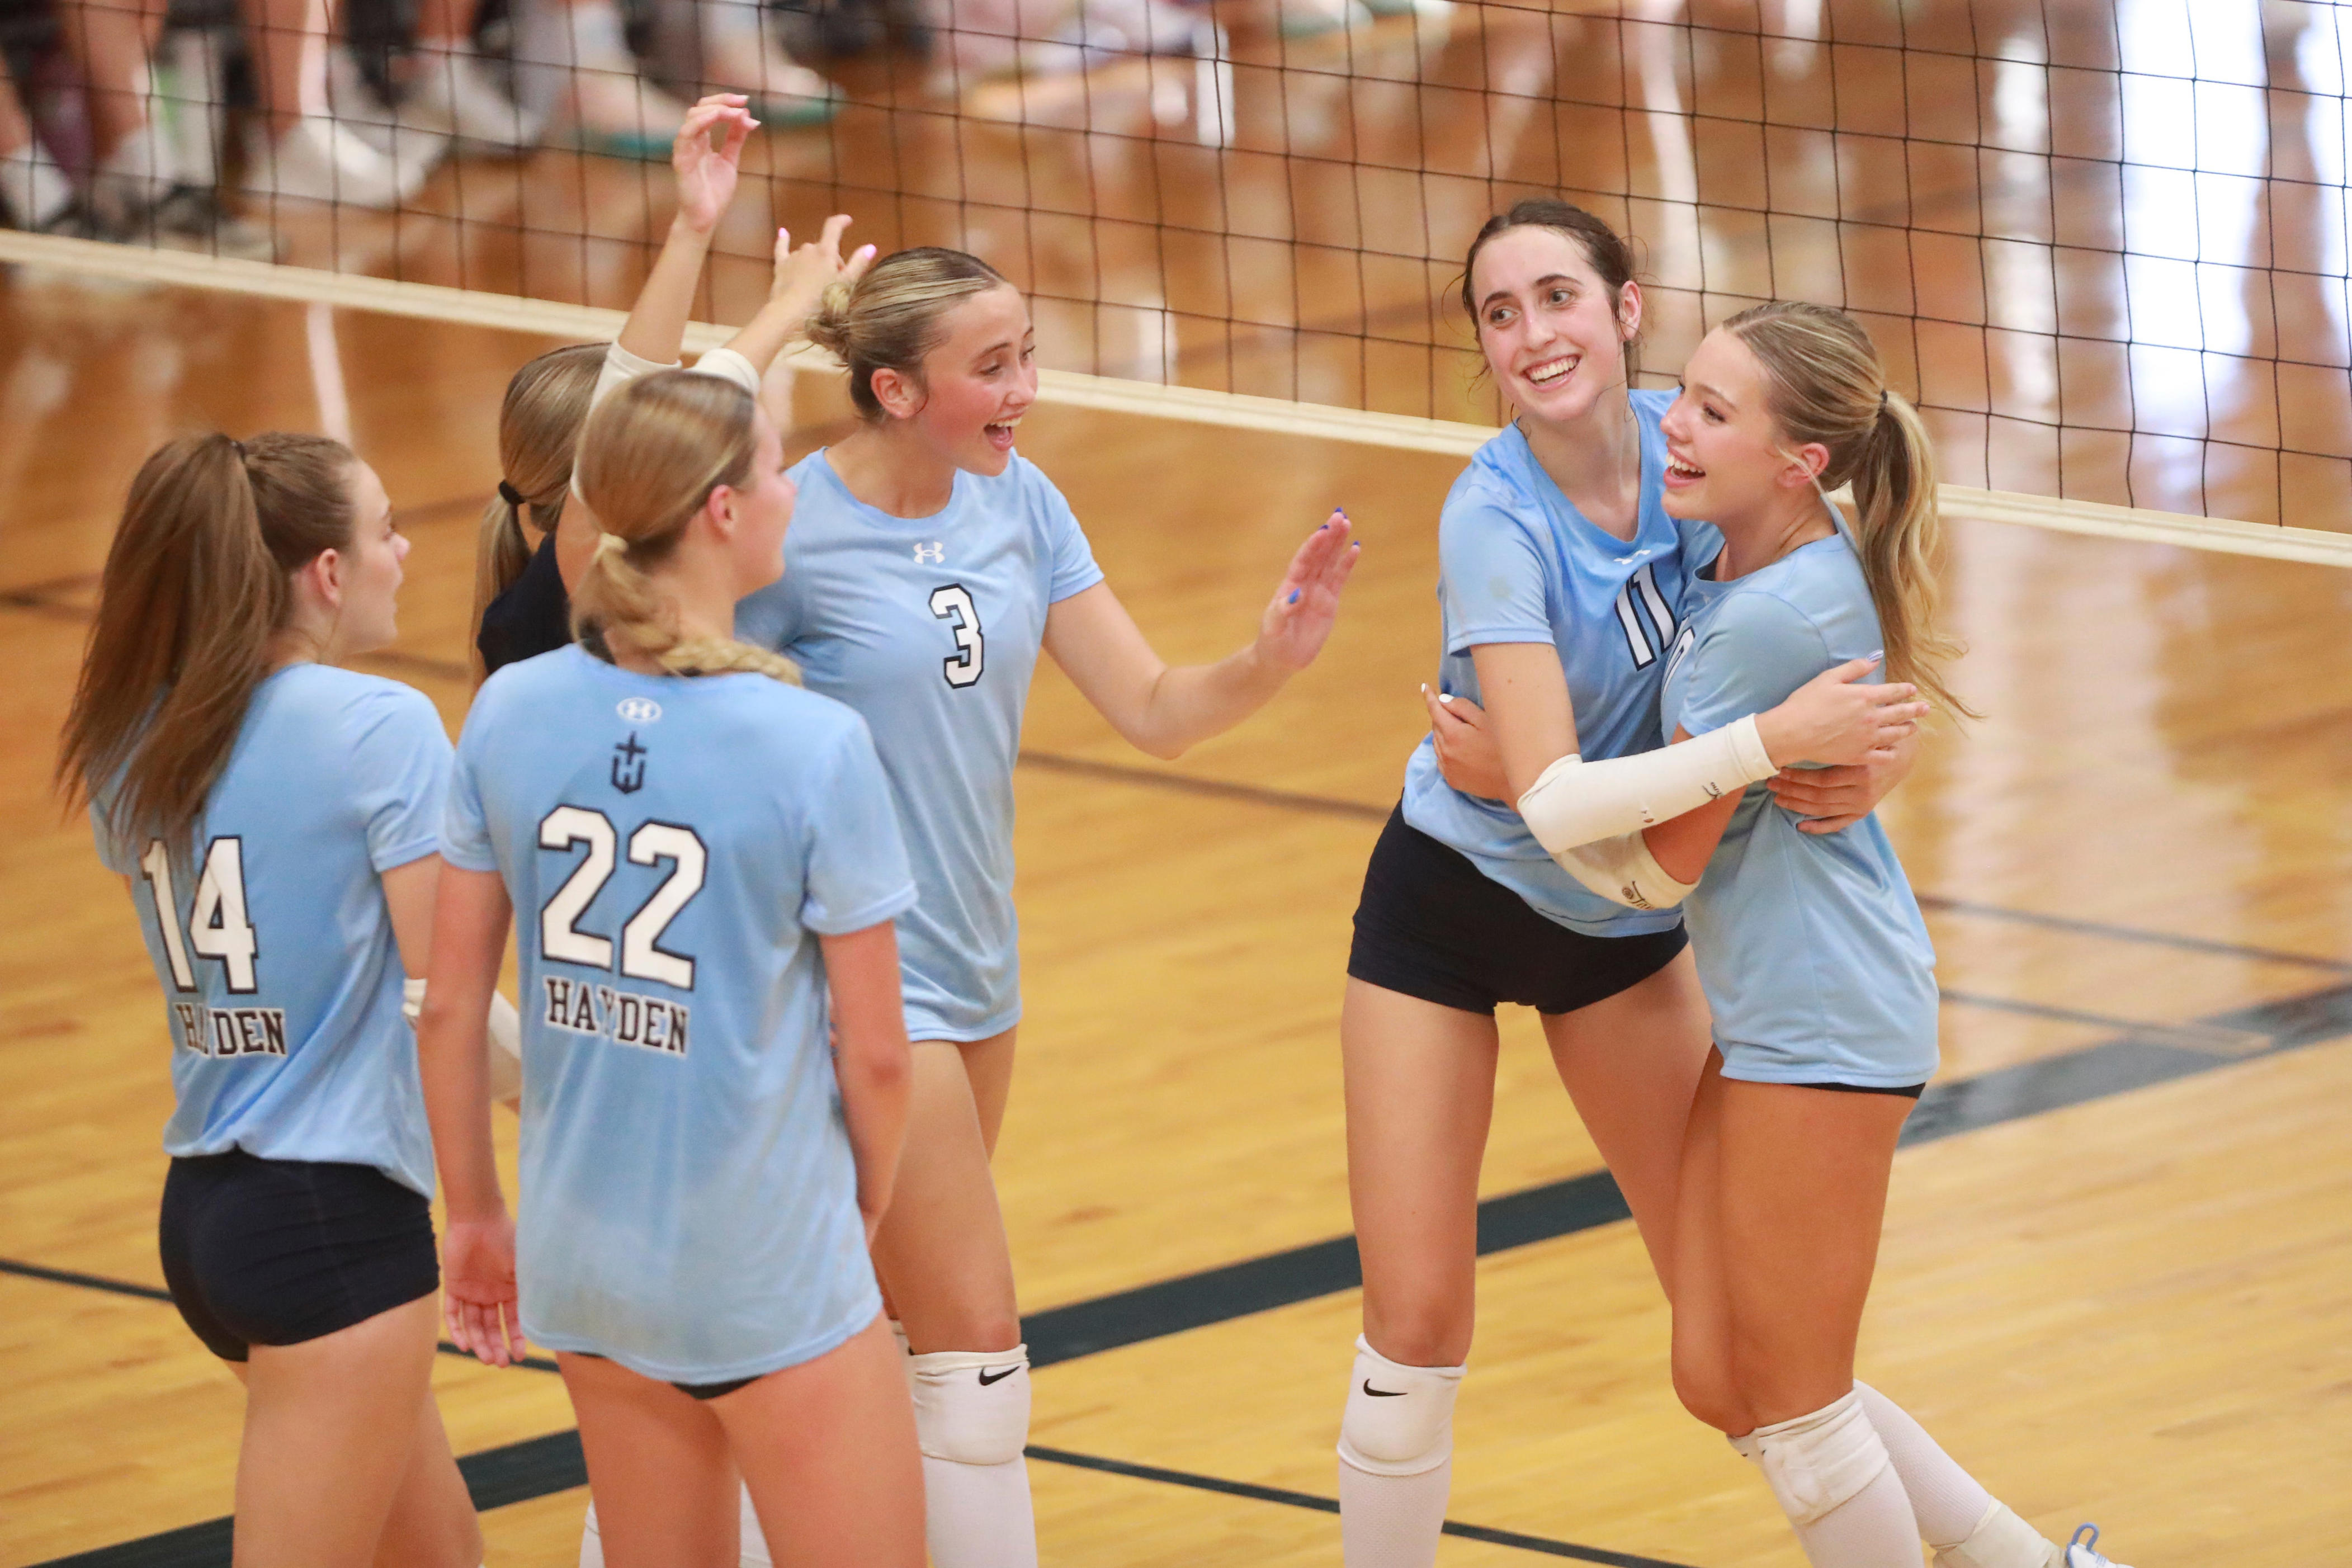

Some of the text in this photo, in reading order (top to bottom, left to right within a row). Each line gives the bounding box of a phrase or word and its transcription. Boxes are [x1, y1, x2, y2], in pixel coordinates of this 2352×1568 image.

[928, 583, 984, 689] 3
[1614, 561, 1678, 672] 11
[141, 834, 259, 994] 14
[538, 804, 708, 991] 22
[174, 1004, 287, 1056] HDEN
[544, 976, 689, 1056] HAYDEN
